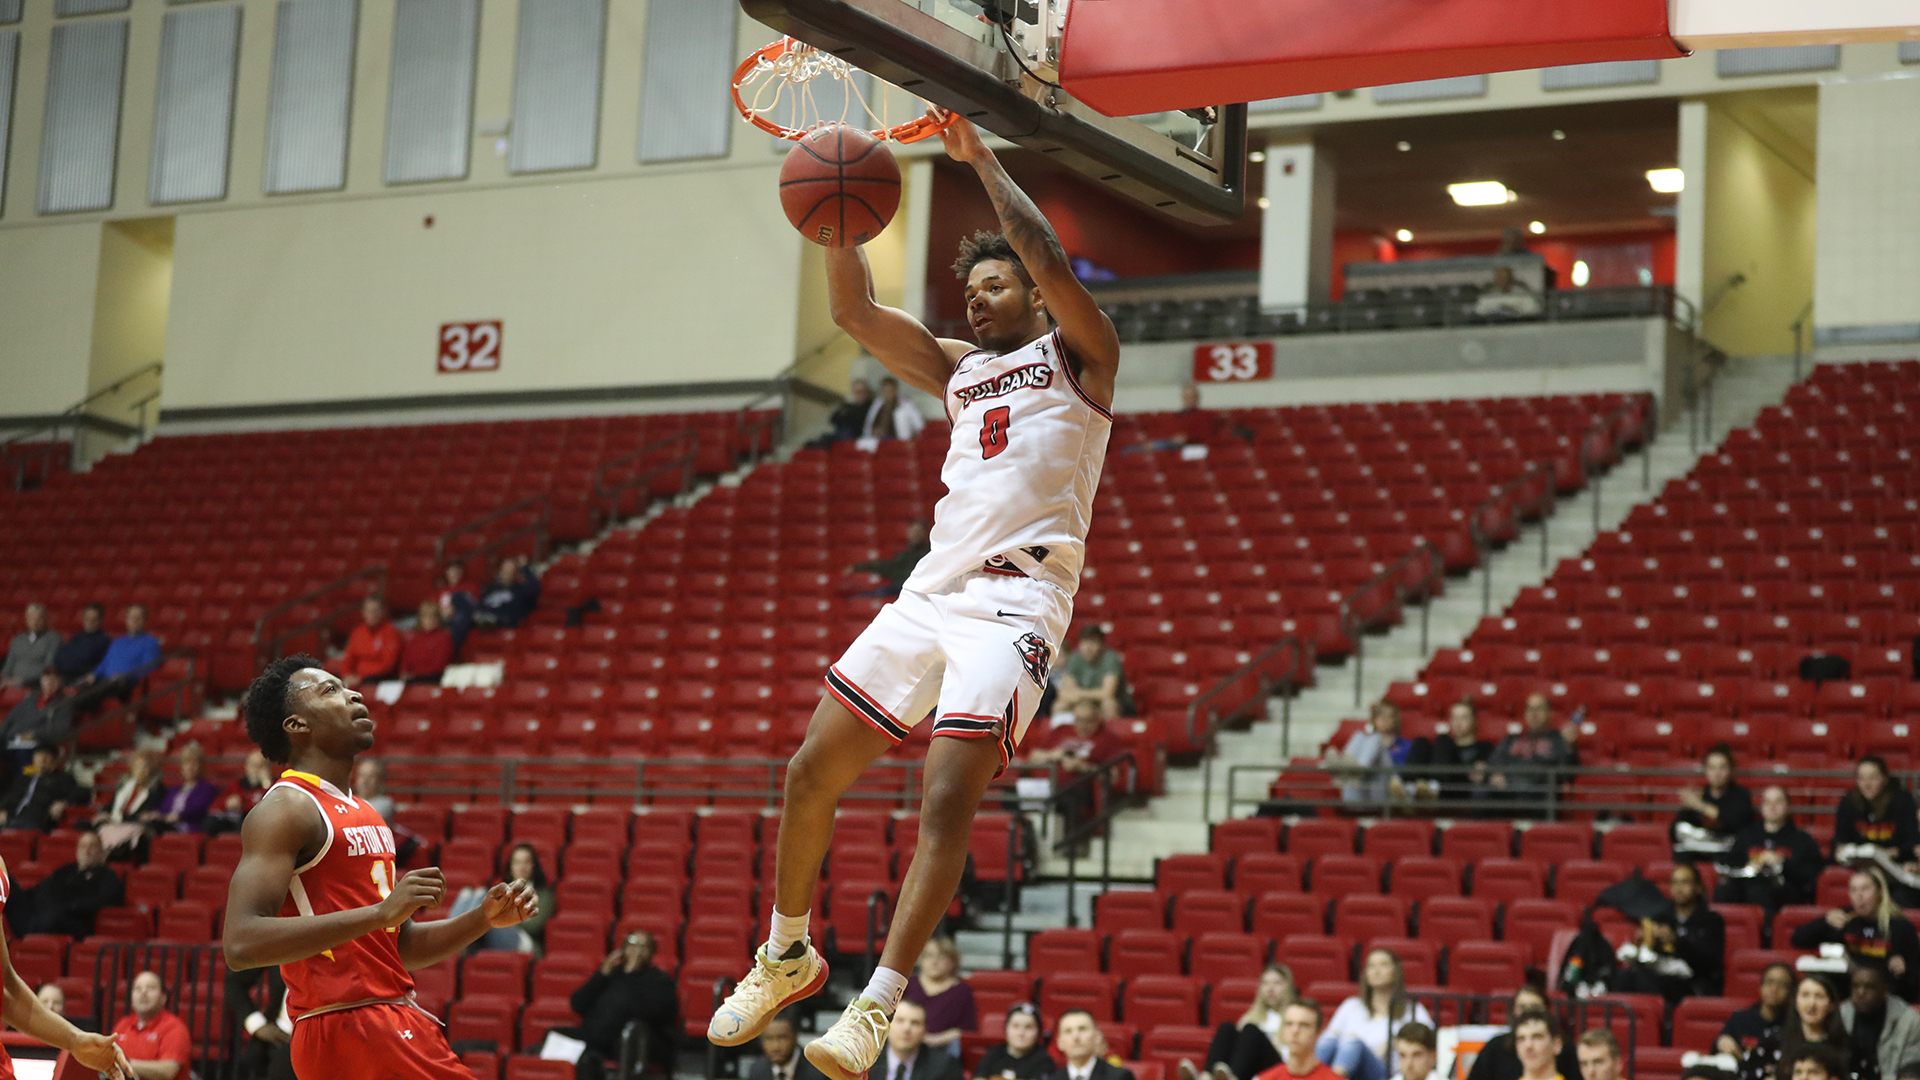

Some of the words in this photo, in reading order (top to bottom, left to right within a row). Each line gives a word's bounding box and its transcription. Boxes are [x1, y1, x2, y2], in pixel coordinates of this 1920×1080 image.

[441, 326, 498, 369] 32
[1208, 345, 1259, 380] 33
[956, 363, 1053, 408] VULCANS
[979, 405, 1010, 460] 0
[342, 825, 385, 856] SETON
